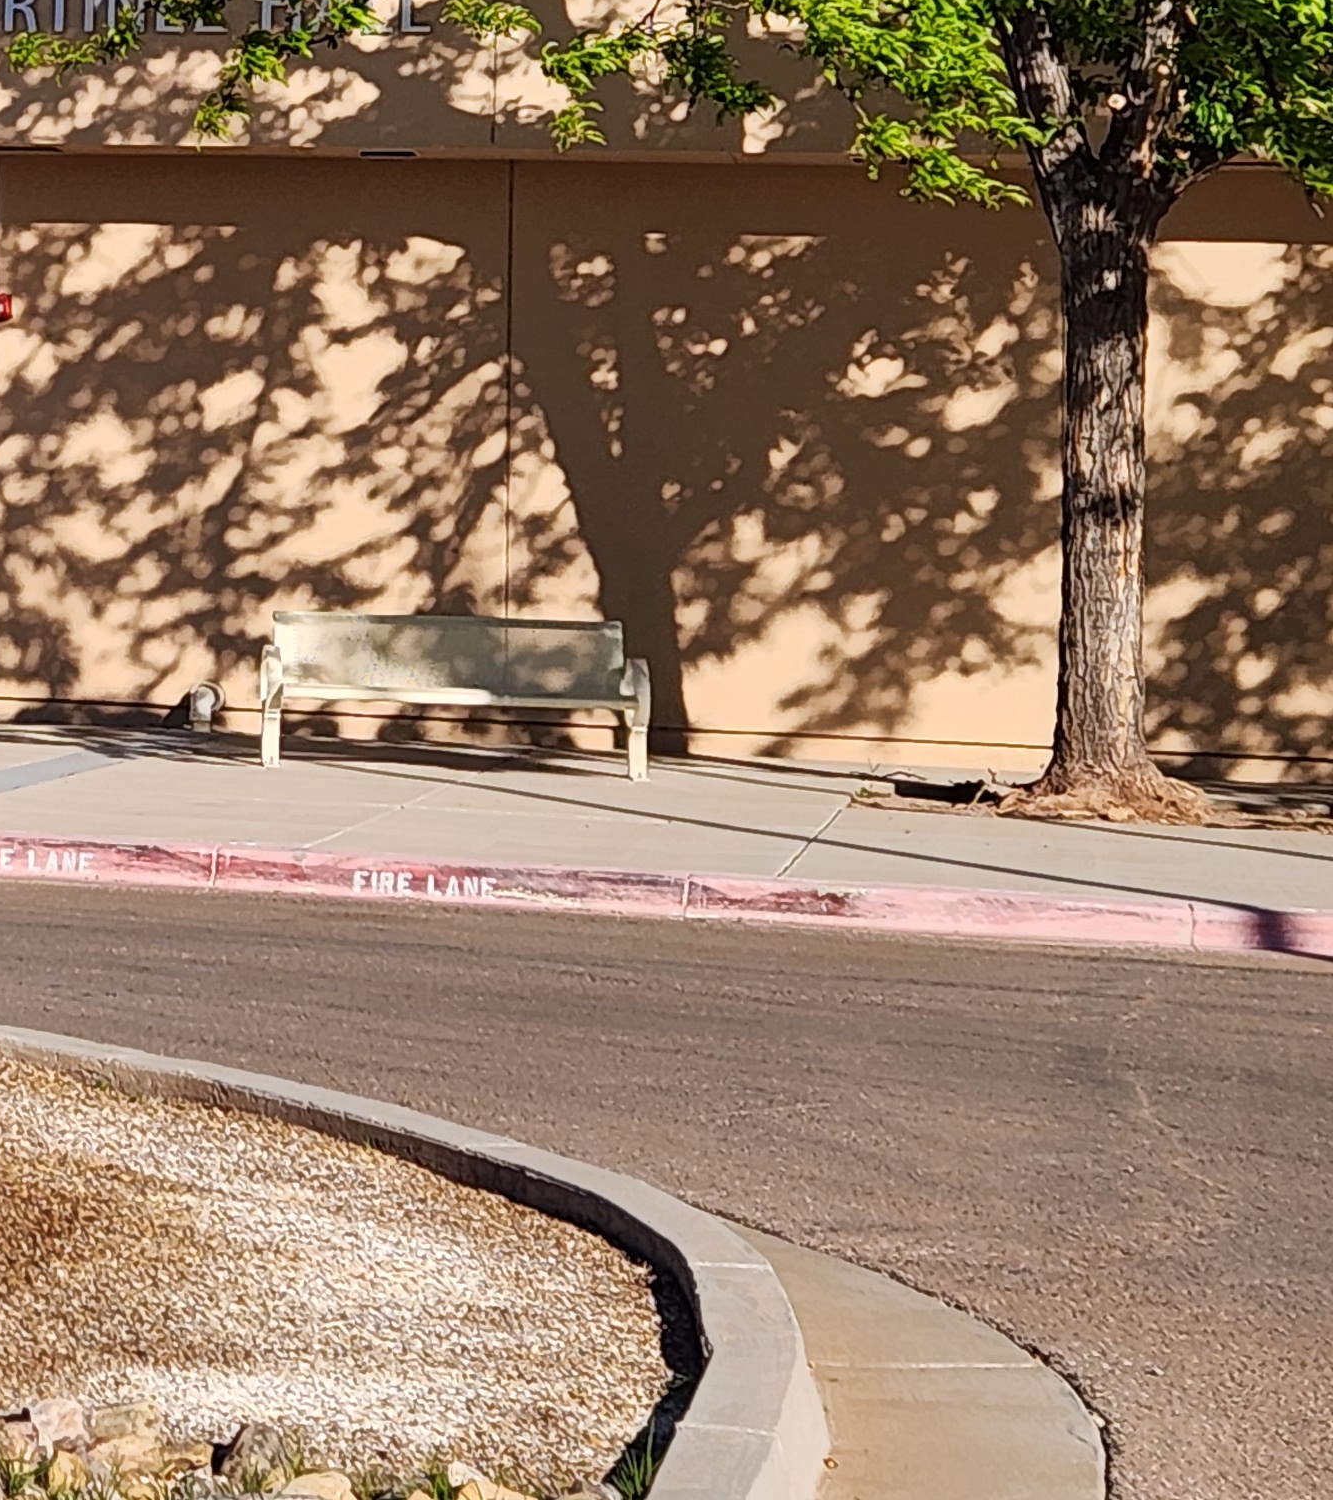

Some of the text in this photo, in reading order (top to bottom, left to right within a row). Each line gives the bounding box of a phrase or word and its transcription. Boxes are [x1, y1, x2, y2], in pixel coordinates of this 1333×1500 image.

[26, 849, 95, 875] LANE
[353, 870, 498, 900] FIRE LANE
